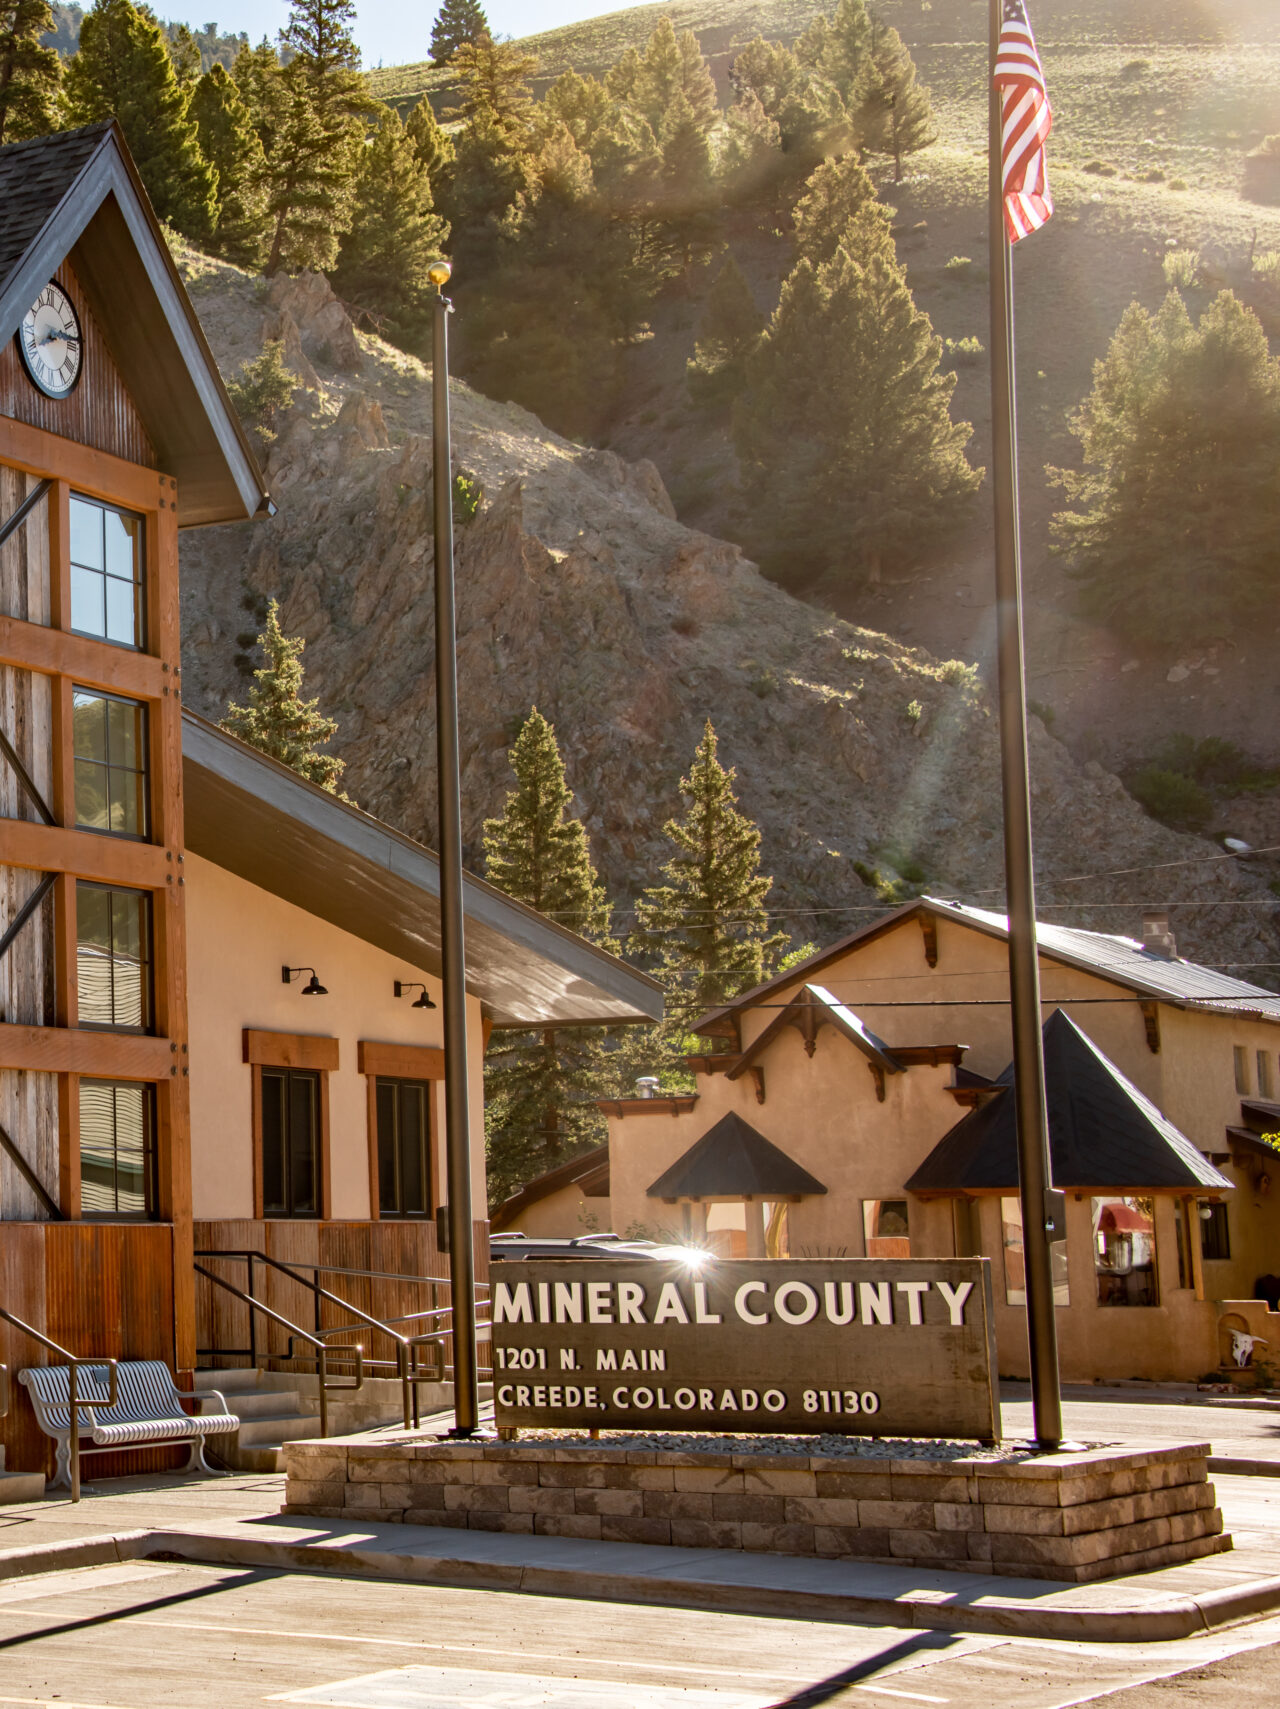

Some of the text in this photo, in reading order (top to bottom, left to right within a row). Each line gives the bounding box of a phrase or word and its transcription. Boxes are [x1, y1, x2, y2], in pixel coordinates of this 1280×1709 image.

[493, 1280, 974, 1326] MINERAL COUNTY
[496, 1347, 666, 1371] 1201 N. MAIN
[497, 1384, 879, 1415] CREEDE, COLORADO 81130
